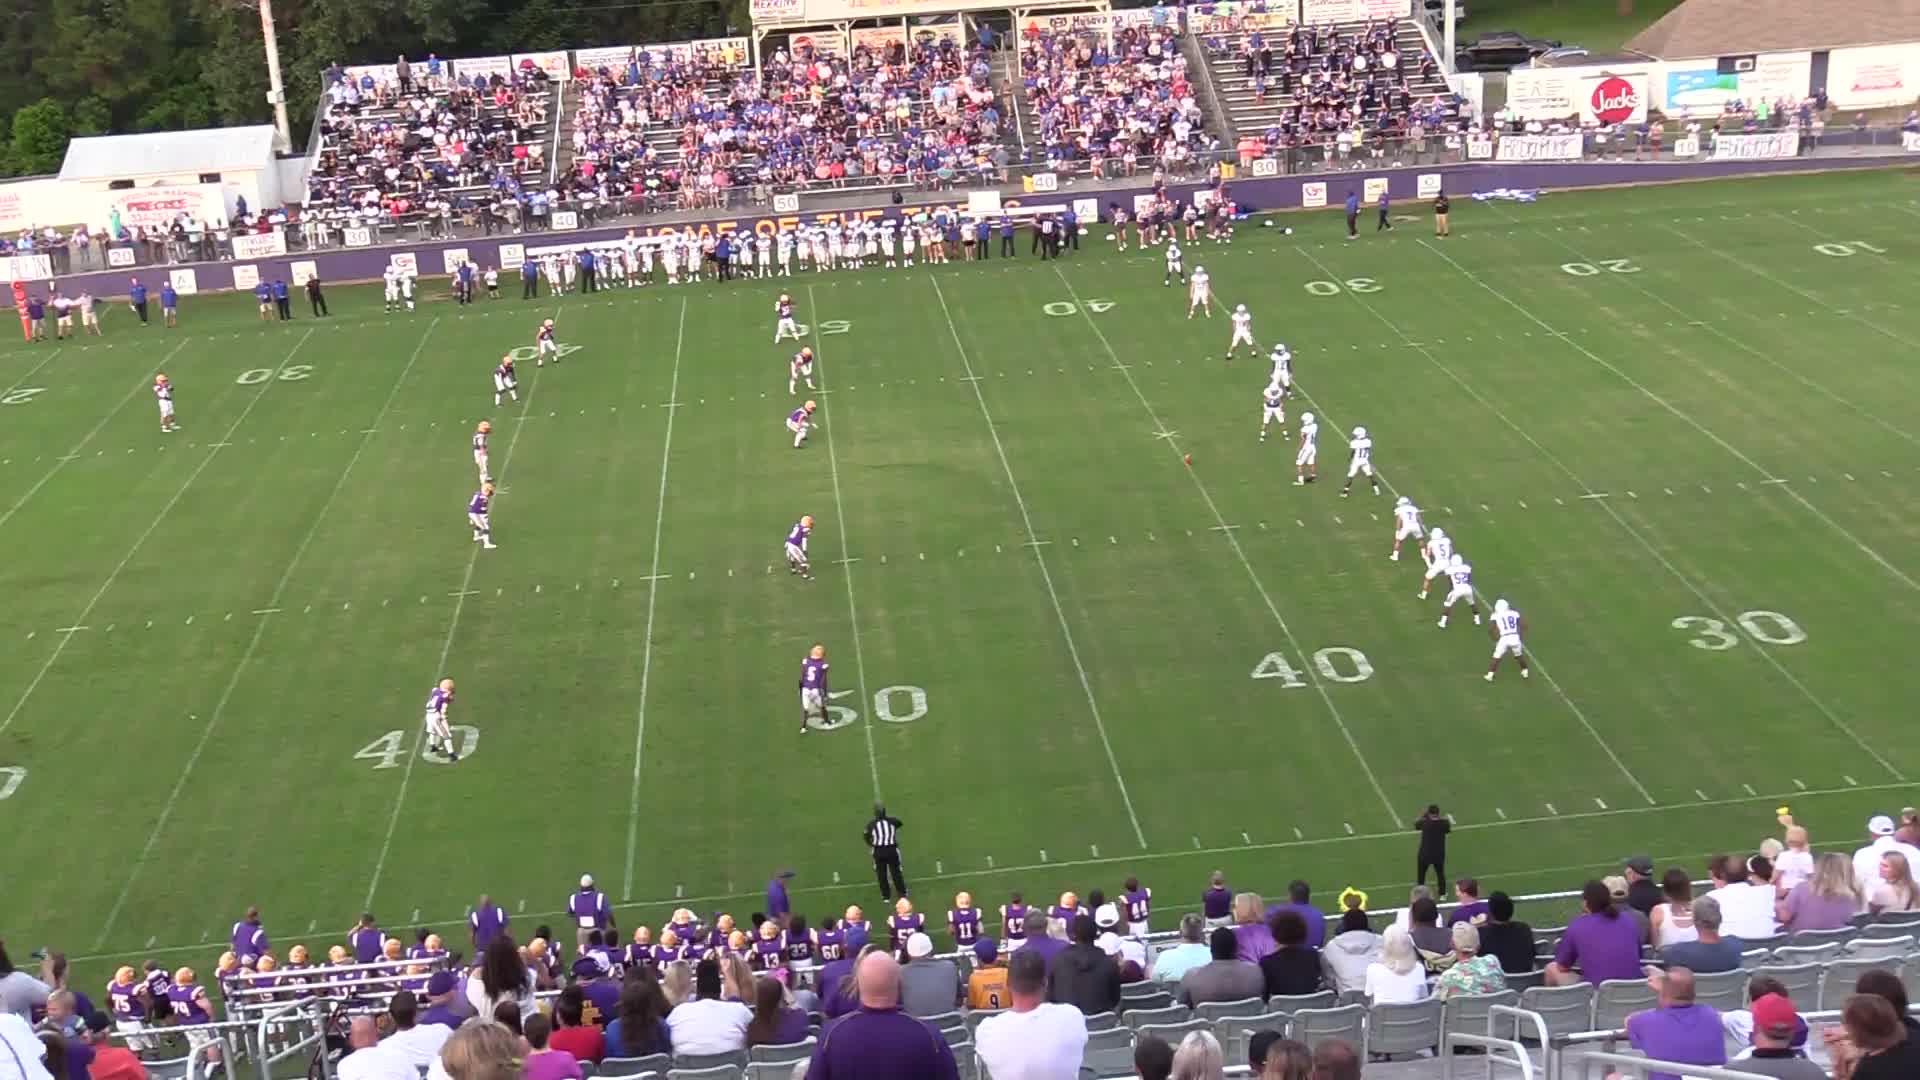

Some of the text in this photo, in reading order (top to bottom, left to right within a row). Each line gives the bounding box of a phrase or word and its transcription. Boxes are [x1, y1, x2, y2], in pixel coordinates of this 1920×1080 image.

[1471, 143, 1490, 156] 20
[1255, 161, 1274, 173] 30
[1035, 176, 1054, 188] 40
[777, 197, 797, 209] 50
[556, 215, 575, 228] 40
[348, 230, 368, 244] 30
[1812, 240, 1888, 256] 10
[110, 250, 133, 265] 20
[1560, 258, 1641, 276] 20
[1303, 278, 1384, 295] 30
[1043, 299, 1116, 316] 40
[235, 364, 313, 384] 30
[1502, 615, 1516, 631] 18
[1671, 610, 1808, 651] 30
[807, 666, 817, 681] 5
[1251, 646, 1375, 689] 40
[353, 724, 480, 769] 40
[959, 922, 973, 939] 11
[821, 944, 840, 960] 60
[763, 953, 780, 969] 13
[112, 993, 131, 1013] 75
